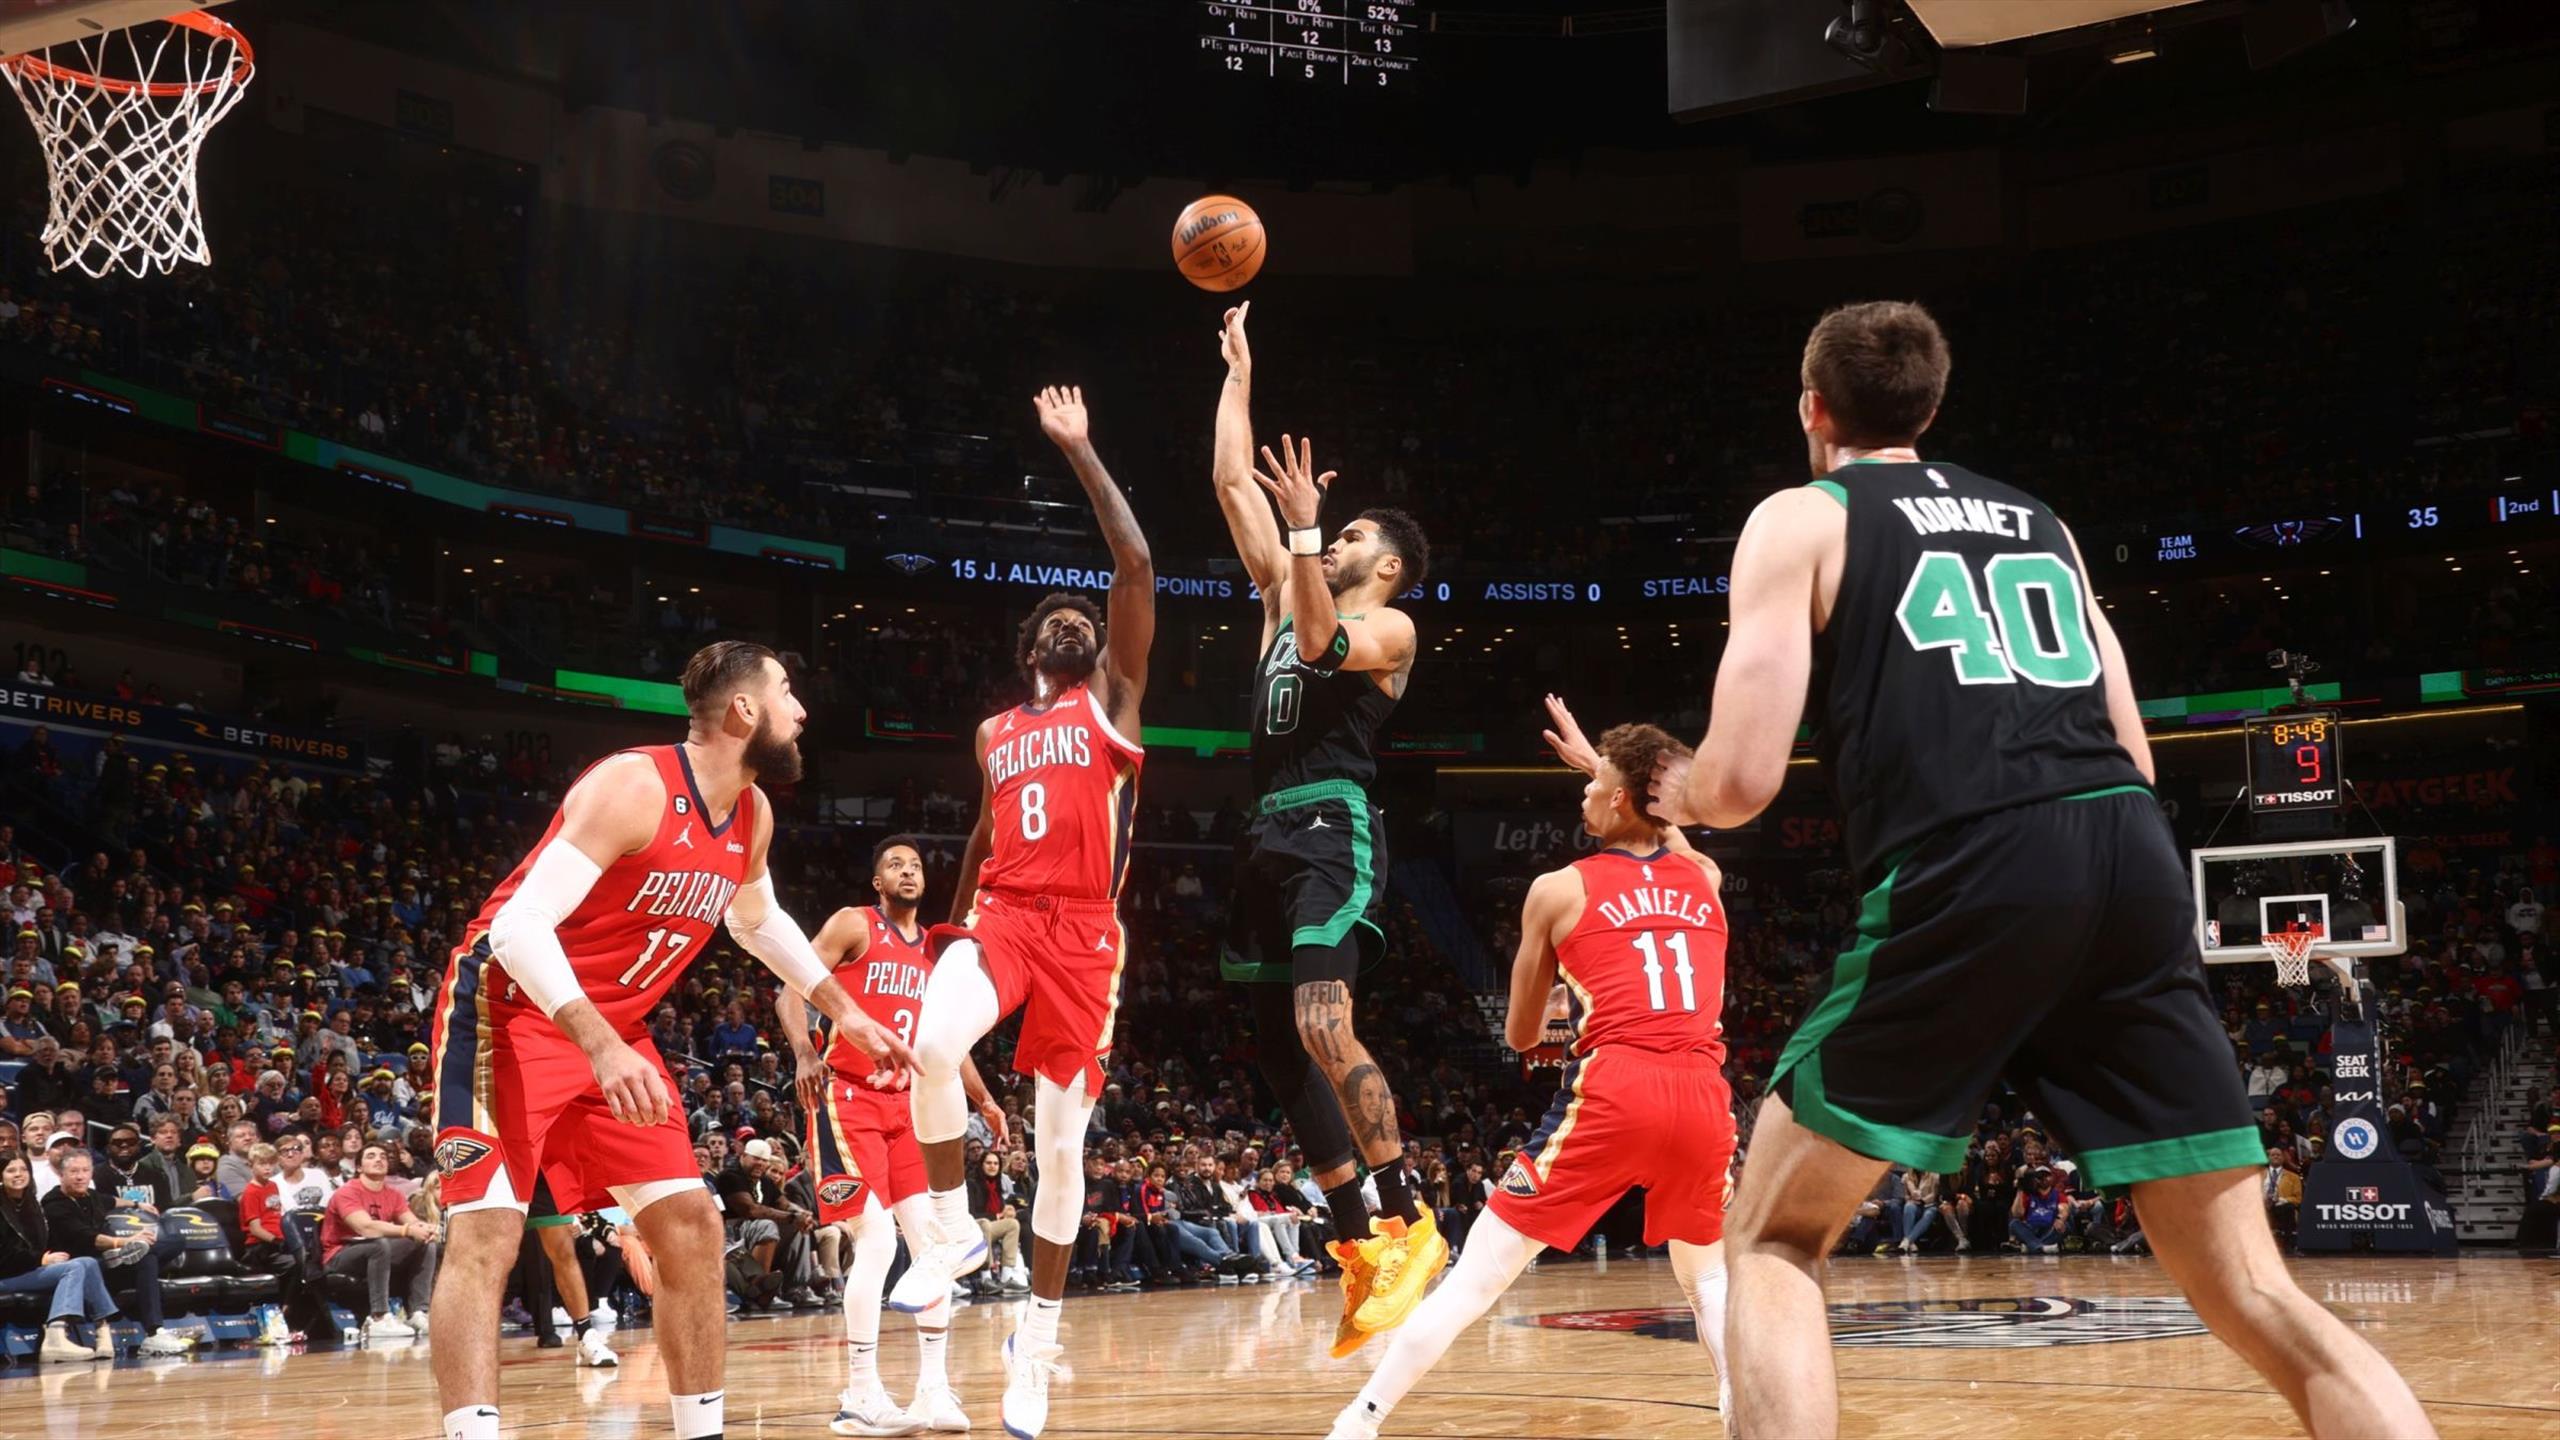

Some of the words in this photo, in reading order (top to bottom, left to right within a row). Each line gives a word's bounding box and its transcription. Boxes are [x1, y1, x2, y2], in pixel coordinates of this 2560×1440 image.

[1367, 6, 1399, 22] 52%
[1228, 22, 1235, 36] 1
[1301, 31, 1320, 45] 12
[1374, 38, 1392, 53] 13
[1225, 56, 1244, 71] 12
[1305, 64, 1315, 79] 5
[1377, 72, 1388, 87] 3
[1181, 211, 1239, 245] Wilson
[1892, 496, 2033, 541] KORNET
[2408, 507, 2439, 528] 35
[2508, 499, 2540, 514] 2nd
[2158, 547, 2197, 561] FOULS
[2160, 535, 2192, 548] TEAM
[951, 559, 977, 579] 15
[984, 562, 1002, 581] J.
[1155, 576, 1232, 597] POINTS
[1438, 583, 1450, 601] 0
[1484, 583, 1575, 601] ASSISTS
[1588, 583, 1600, 601] 0
[1643, 576, 1729, 597] STEALS
[1895, 551, 2102, 688] 40
[0, 689, 144, 727] BETRIVERS
[1266, 673, 1303, 735] 0
[223, 725, 350, 761] BETRIVERS
[2274, 720, 2325, 745] 8:49
[987, 725, 1091, 793] PELICANS
[2297, 746, 2320, 783] 9
[675, 796, 687, 814] 6
[2278, 790, 2335, 804] TISSOT
[1020, 782, 1048, 841] 8
[1494, 821, 1565, 851] Let's
[627, 871, 736, 928] PELICANS
[1598, 887, 1712, 928] DANIELS
[618, 927, 692, 990] 17
[1631, 930, 1696, 1012] 11
[864, 961, 926, 1000] PELICA
[893, 1008, 914, 1047] 3
[2335, 1067, 2370, 1078] GEEK
[2336, 1055, 2368, 1067] SEAT
[2316, 1204, 2411, 1220] TISSOT
